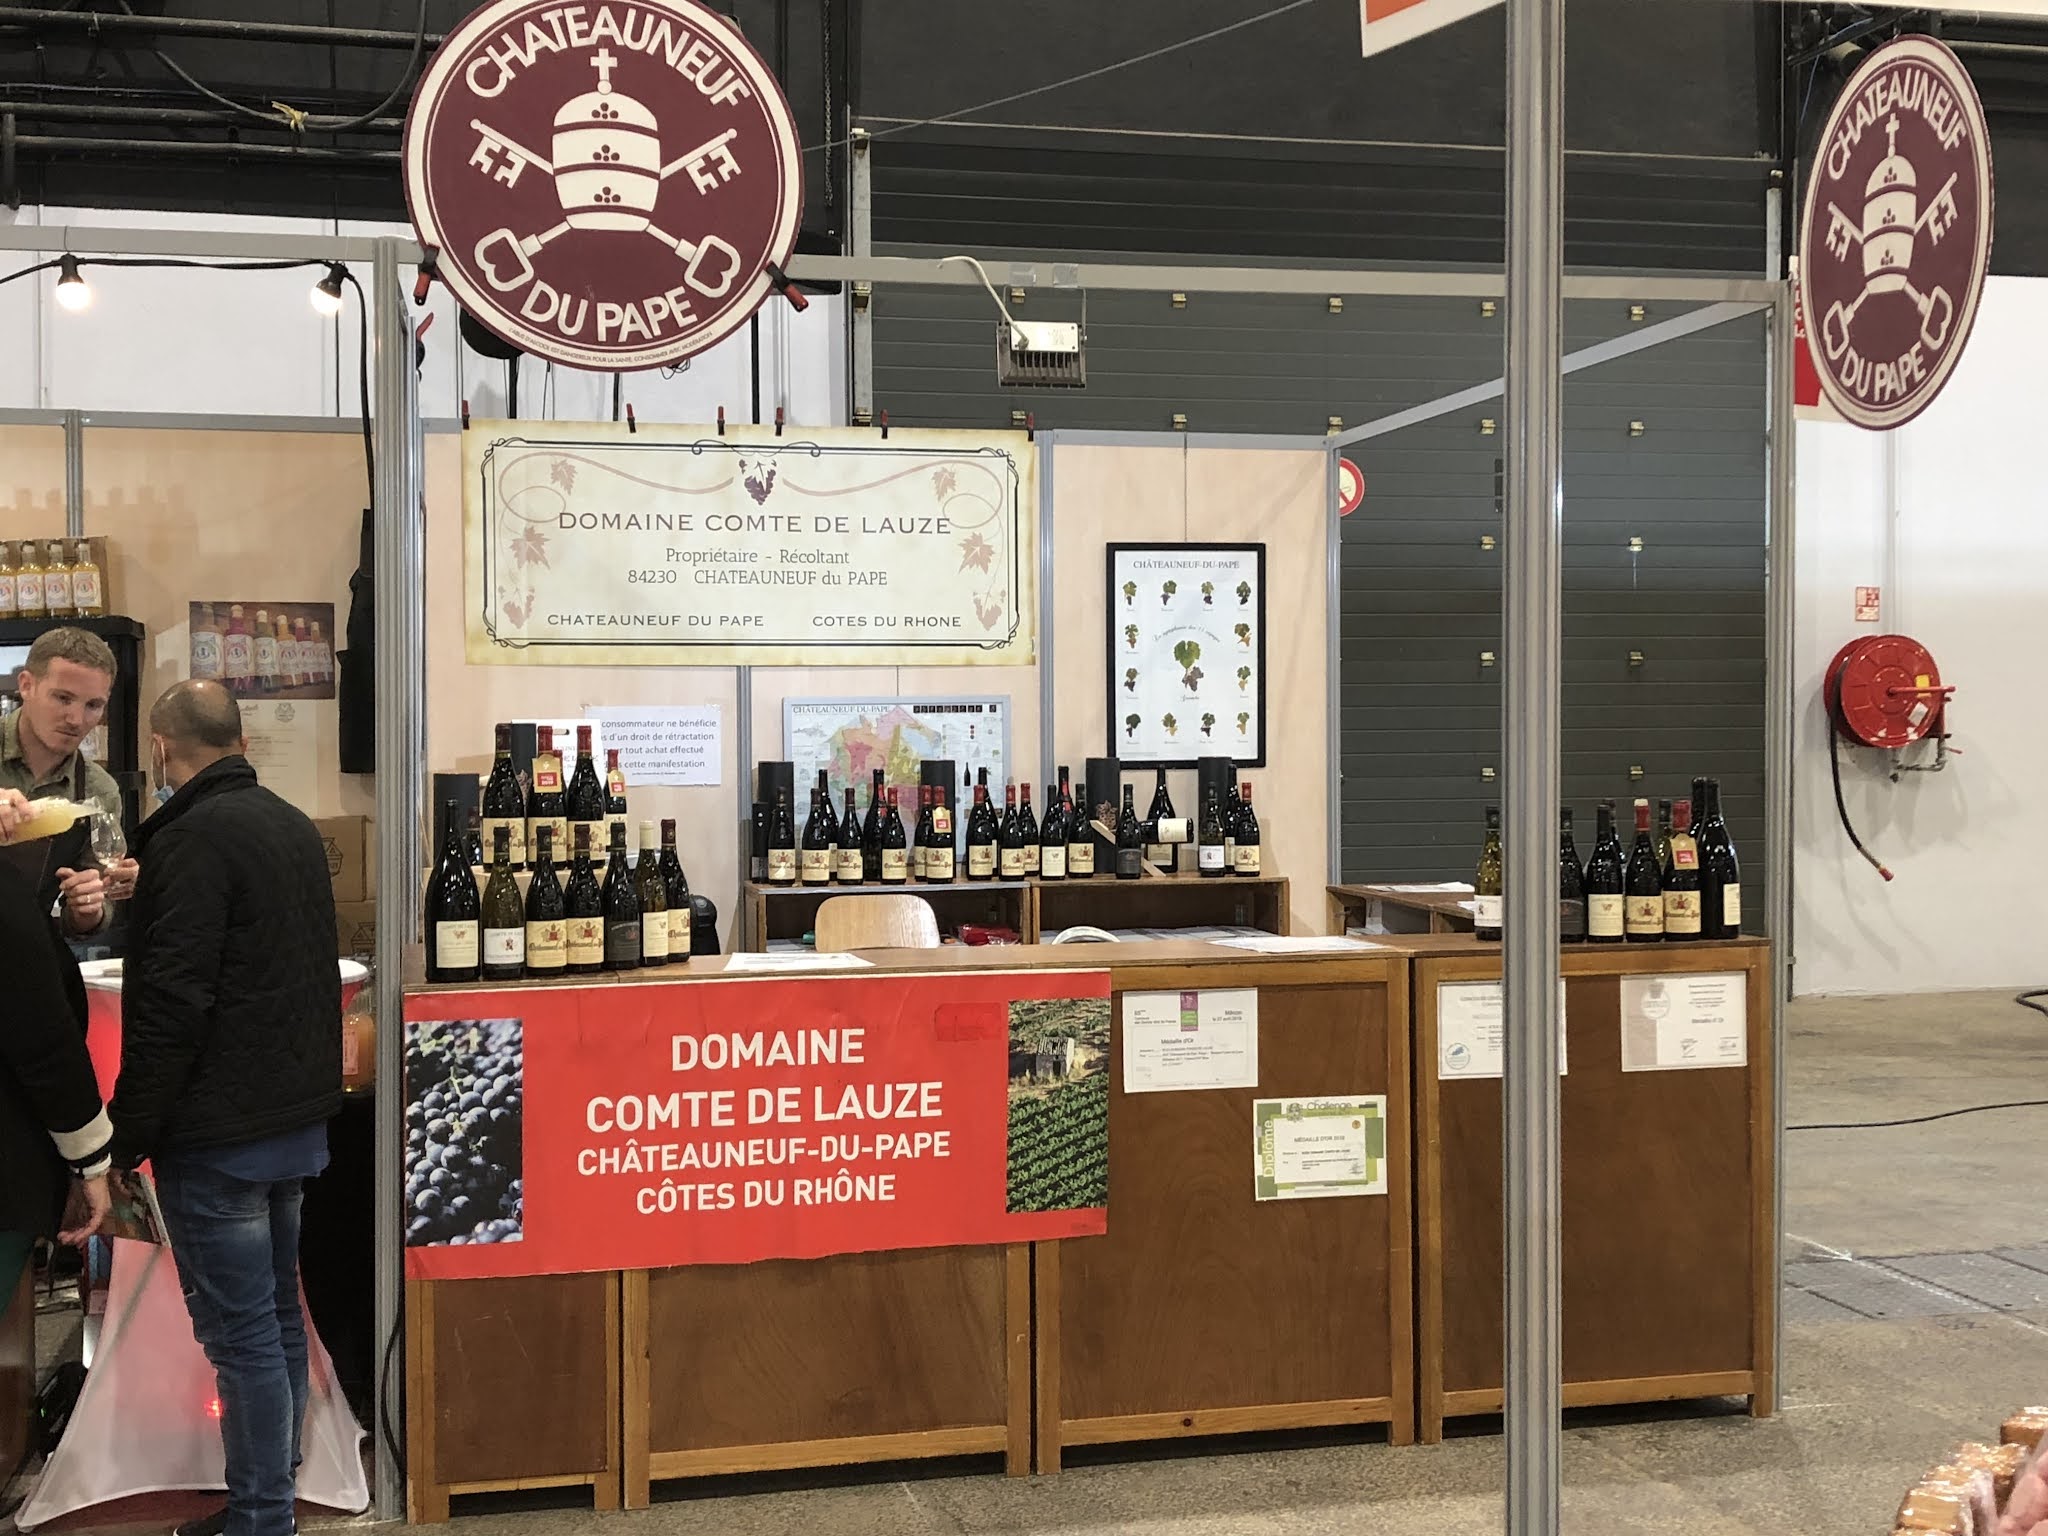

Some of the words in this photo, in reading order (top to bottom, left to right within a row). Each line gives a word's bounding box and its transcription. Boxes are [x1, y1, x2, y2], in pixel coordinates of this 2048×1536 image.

[465, 5, 751, 106] CHATEAUNEUF
[1828, 67, 1967, 180] CHATEAUNEUF
[520, 279, 588, 336] DU
[597, 286, 698, 342] PAPE
[1841, 356, 1873, 399] DU
[1874, 341, 1927, 402] PAPE
[558, 512, 693, 532] DOMAINE
[705, 514, 802, 533] COMTE
[814, 516, 850, 533] DE
[862, 516, 951, 535] LAUZE
[628, 569, 677, 584] 84230
[694, 570, 817, 585] CHATEAUNEUF
[822, 570, 841, 585] du
[848, 571, 888, 586] PAPE
[666, 547, 758, 566] Propriétaire
[779, 547, 850, 564] Récoltant
[547, 614, 682, 626] CHATEAUNEUF
[689, 615, 712, 627] DU
[719, 615, 764, 627] PAPE
[812, 616, 867, 627] COTES
[874, 616, 897, 627] DU
[904, 616, 962, 627] RHONE
[601, 719, 664, 728] consommateur
[667, 720, 677, 728] ne
[679, 719, 717, 728] bénéficie
[609, 733, 628, 741] d'un
[630, 733, 650, 741] droit
[652, 733, 663, 741] de
[665, 733, 714, 741] rétractation
[624, 760, 646, 769] cette
[648, 759, 705, 768] manifestation
[625, 746, 643, 754] tout
[645, 746, 668, 754] achat
[670, 746, 704, 754] effectué
[672, 1028, 865, 1072] DOMAINE
[586, 1090, 736, 1133] COMTE
[747, 1087, 802, 1125] DE
[814, 1081, 943, 1122] LAUZE
[577, 1130, 951, 1176] CHÂTEAUNEUF-DU-PAPE
[1263, 1119, 1274, 1177] Diplôme
[636, 1176, 736, 1215] CÔTES
[744, 1179, 785, 1209] DU
[793, 1167, 896, 1206] RHÔNE
